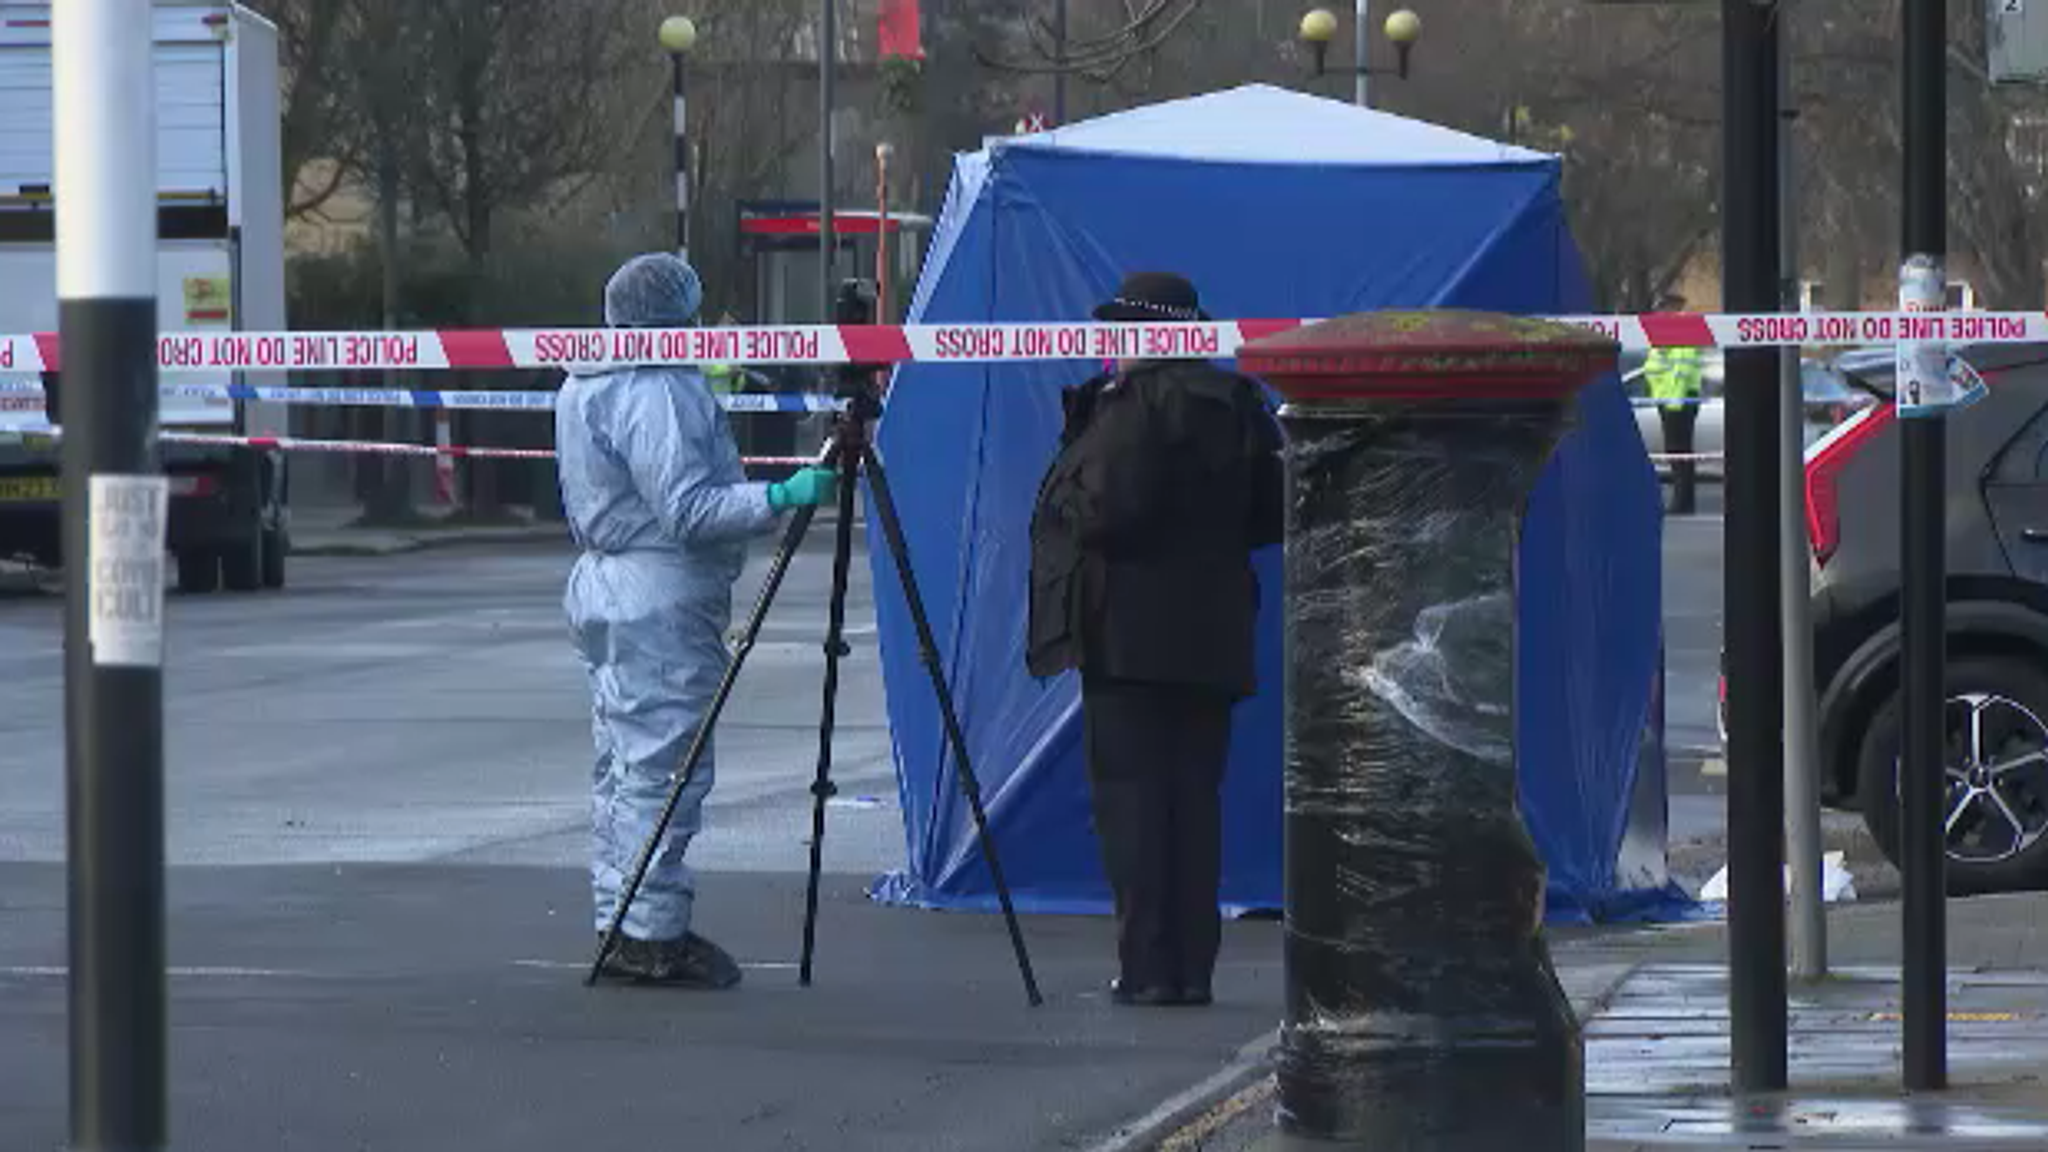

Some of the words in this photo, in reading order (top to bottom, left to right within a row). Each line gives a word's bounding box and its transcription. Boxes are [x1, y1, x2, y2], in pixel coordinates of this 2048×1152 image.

[1011, 329, 1050, 356] NOT
[1057, 329, 1087, 355] DO
[1094, 328, 1140, 354] LINE
[1143, 327, 1218, 353] POLICE
[1738, 318, 1809, 343] CROSS
[1814, 318, 1856, 342] NOT
[1862, 317, 1890, 341] DO
[1898, 316, 1945, 340] LINE
[1952, 316, 2026, 340] POLICE
[159, 337, 203, 368] CRO
[211, 337, 251, 368] NOT
[257, 336, 285, 366] DO
[293, 335, 339, 366] LINE
[346, 335, 419, 366] POLICE
[534, 332, 607, 363] CROSS
[611, 332, 650, 362] NOT
[660, 332, 685, 361] DO
[693, 331, 740, 360] LINE
[746, 330, 819, 359] POLICE
[935, 329, 1005, 358] CROSS
